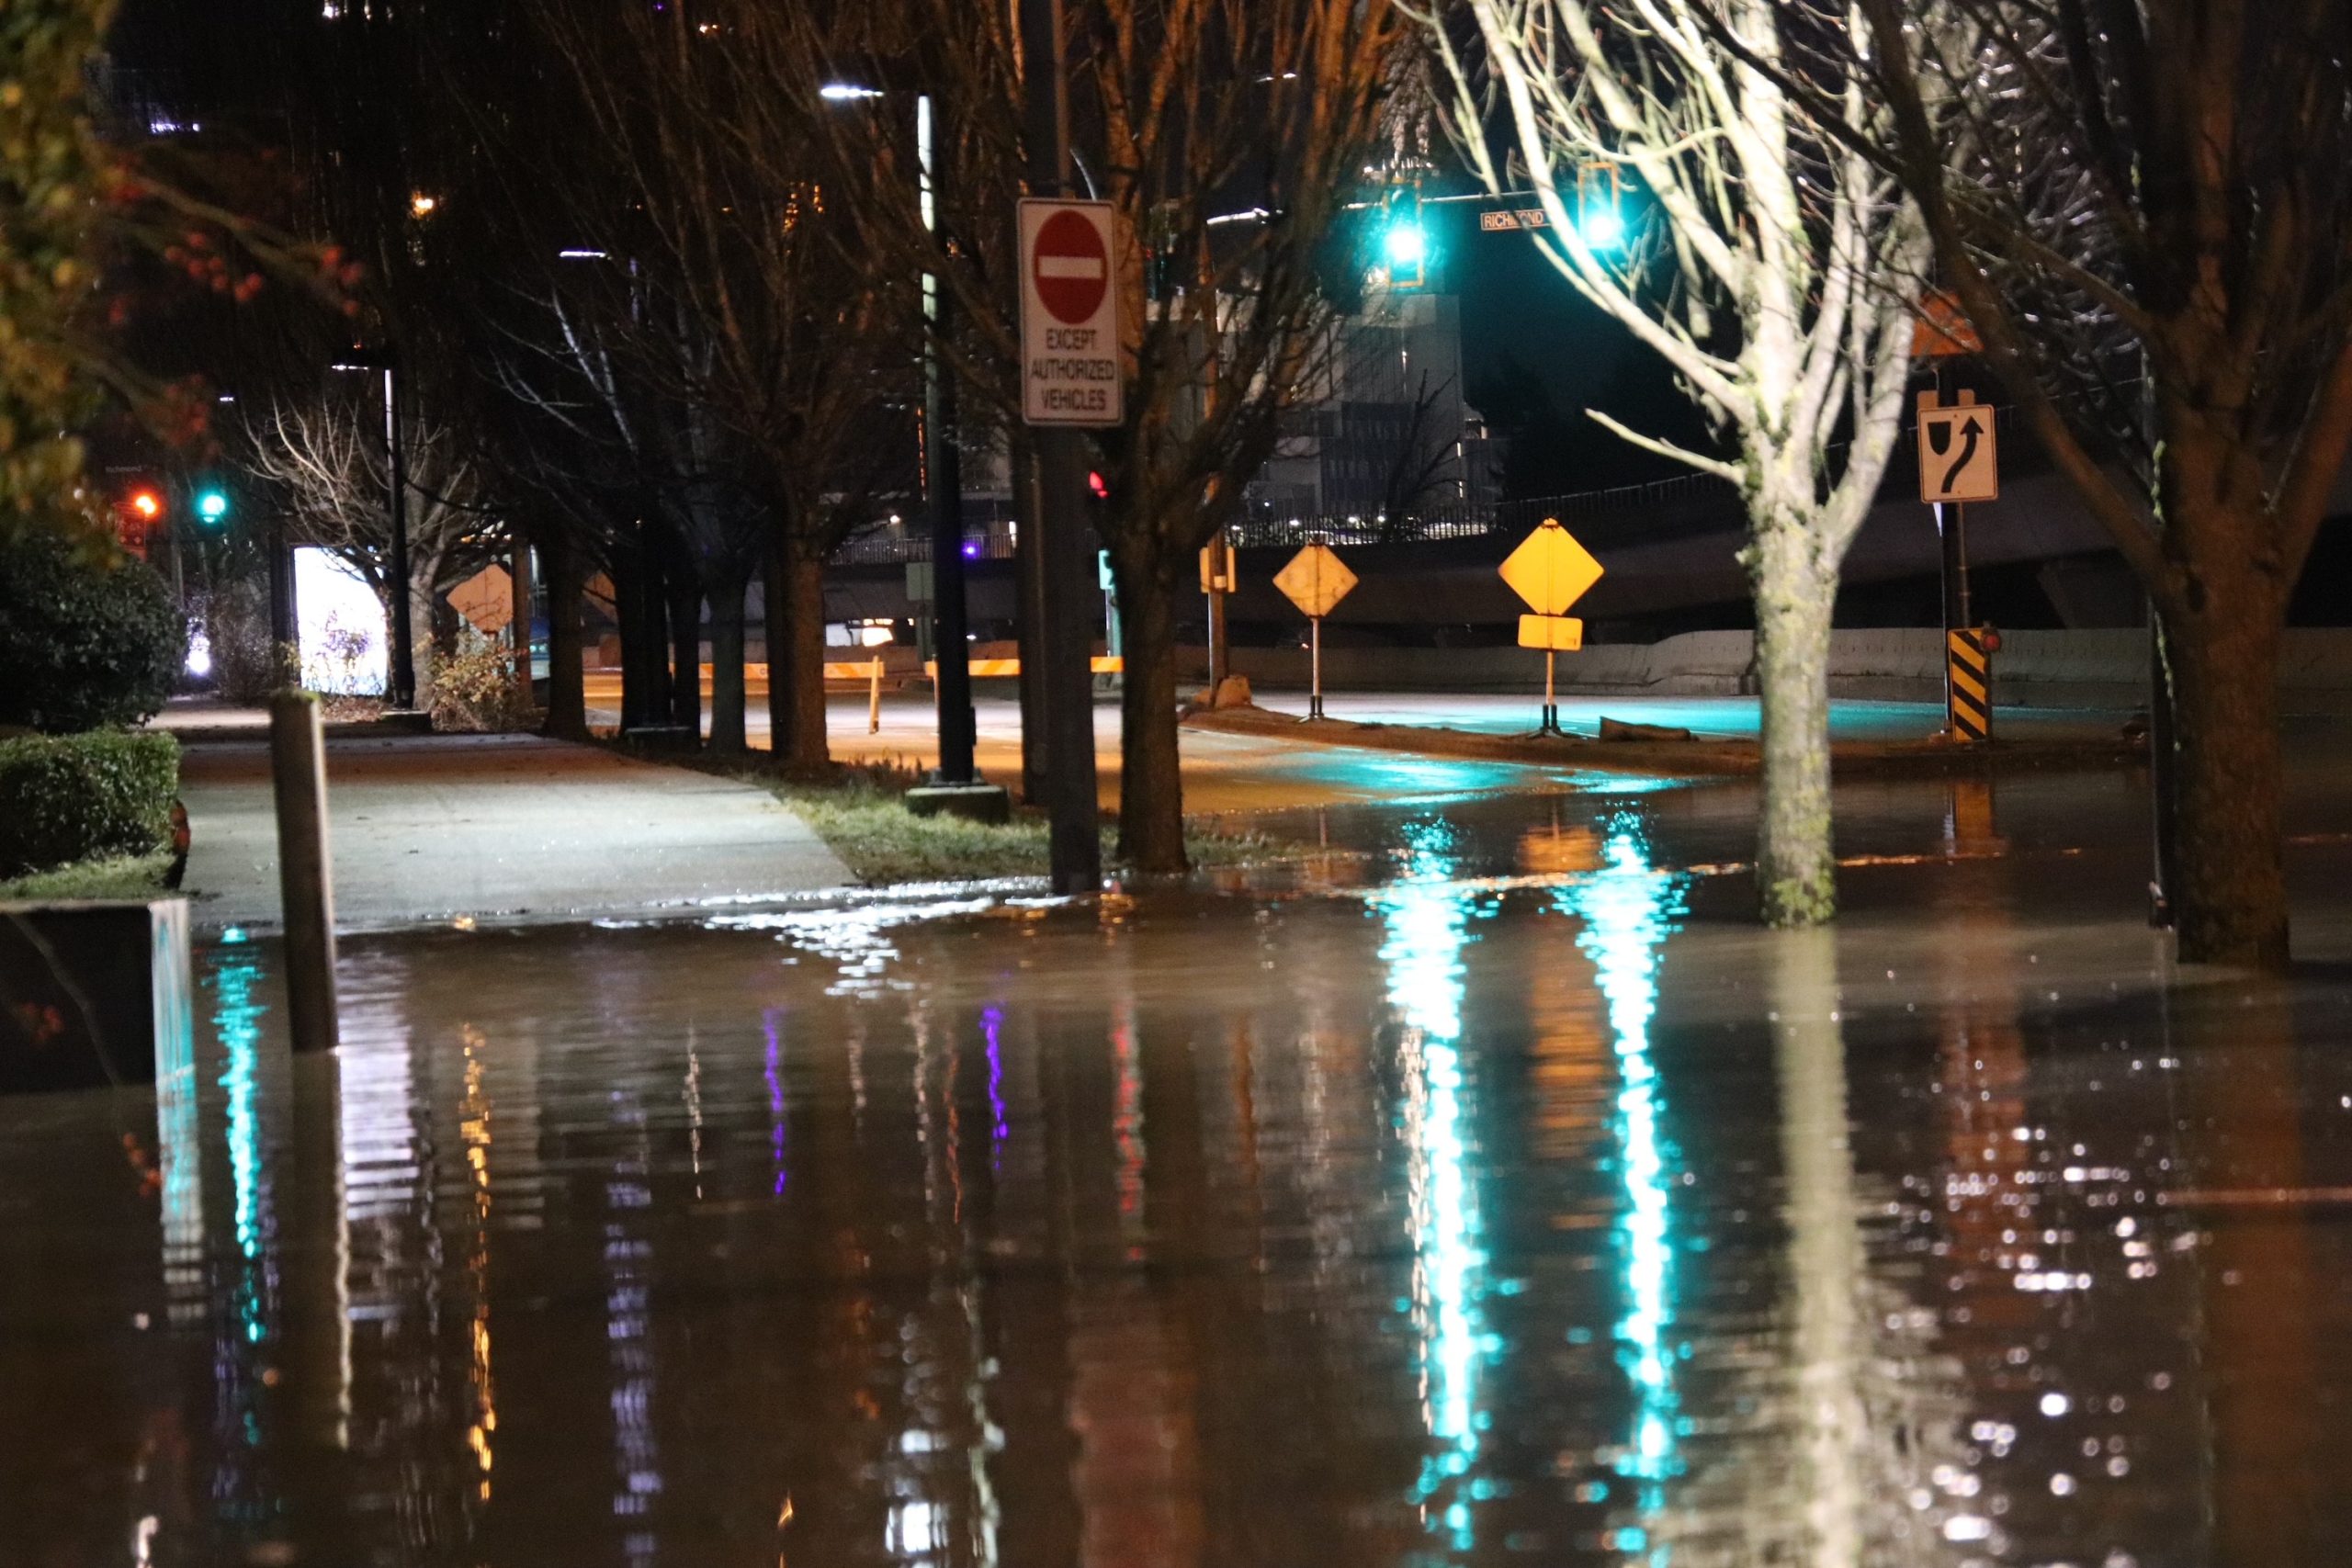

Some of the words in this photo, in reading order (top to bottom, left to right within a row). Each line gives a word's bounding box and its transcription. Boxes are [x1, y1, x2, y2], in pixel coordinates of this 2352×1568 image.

[1484, 211, 1544, 228] RICHOND
[1046, 328, 1097, 350] EXCEPT
[1030, 358, 1115, 380] AUTHORIZED
[1041, 388, 1106, 411] VEHICLES
